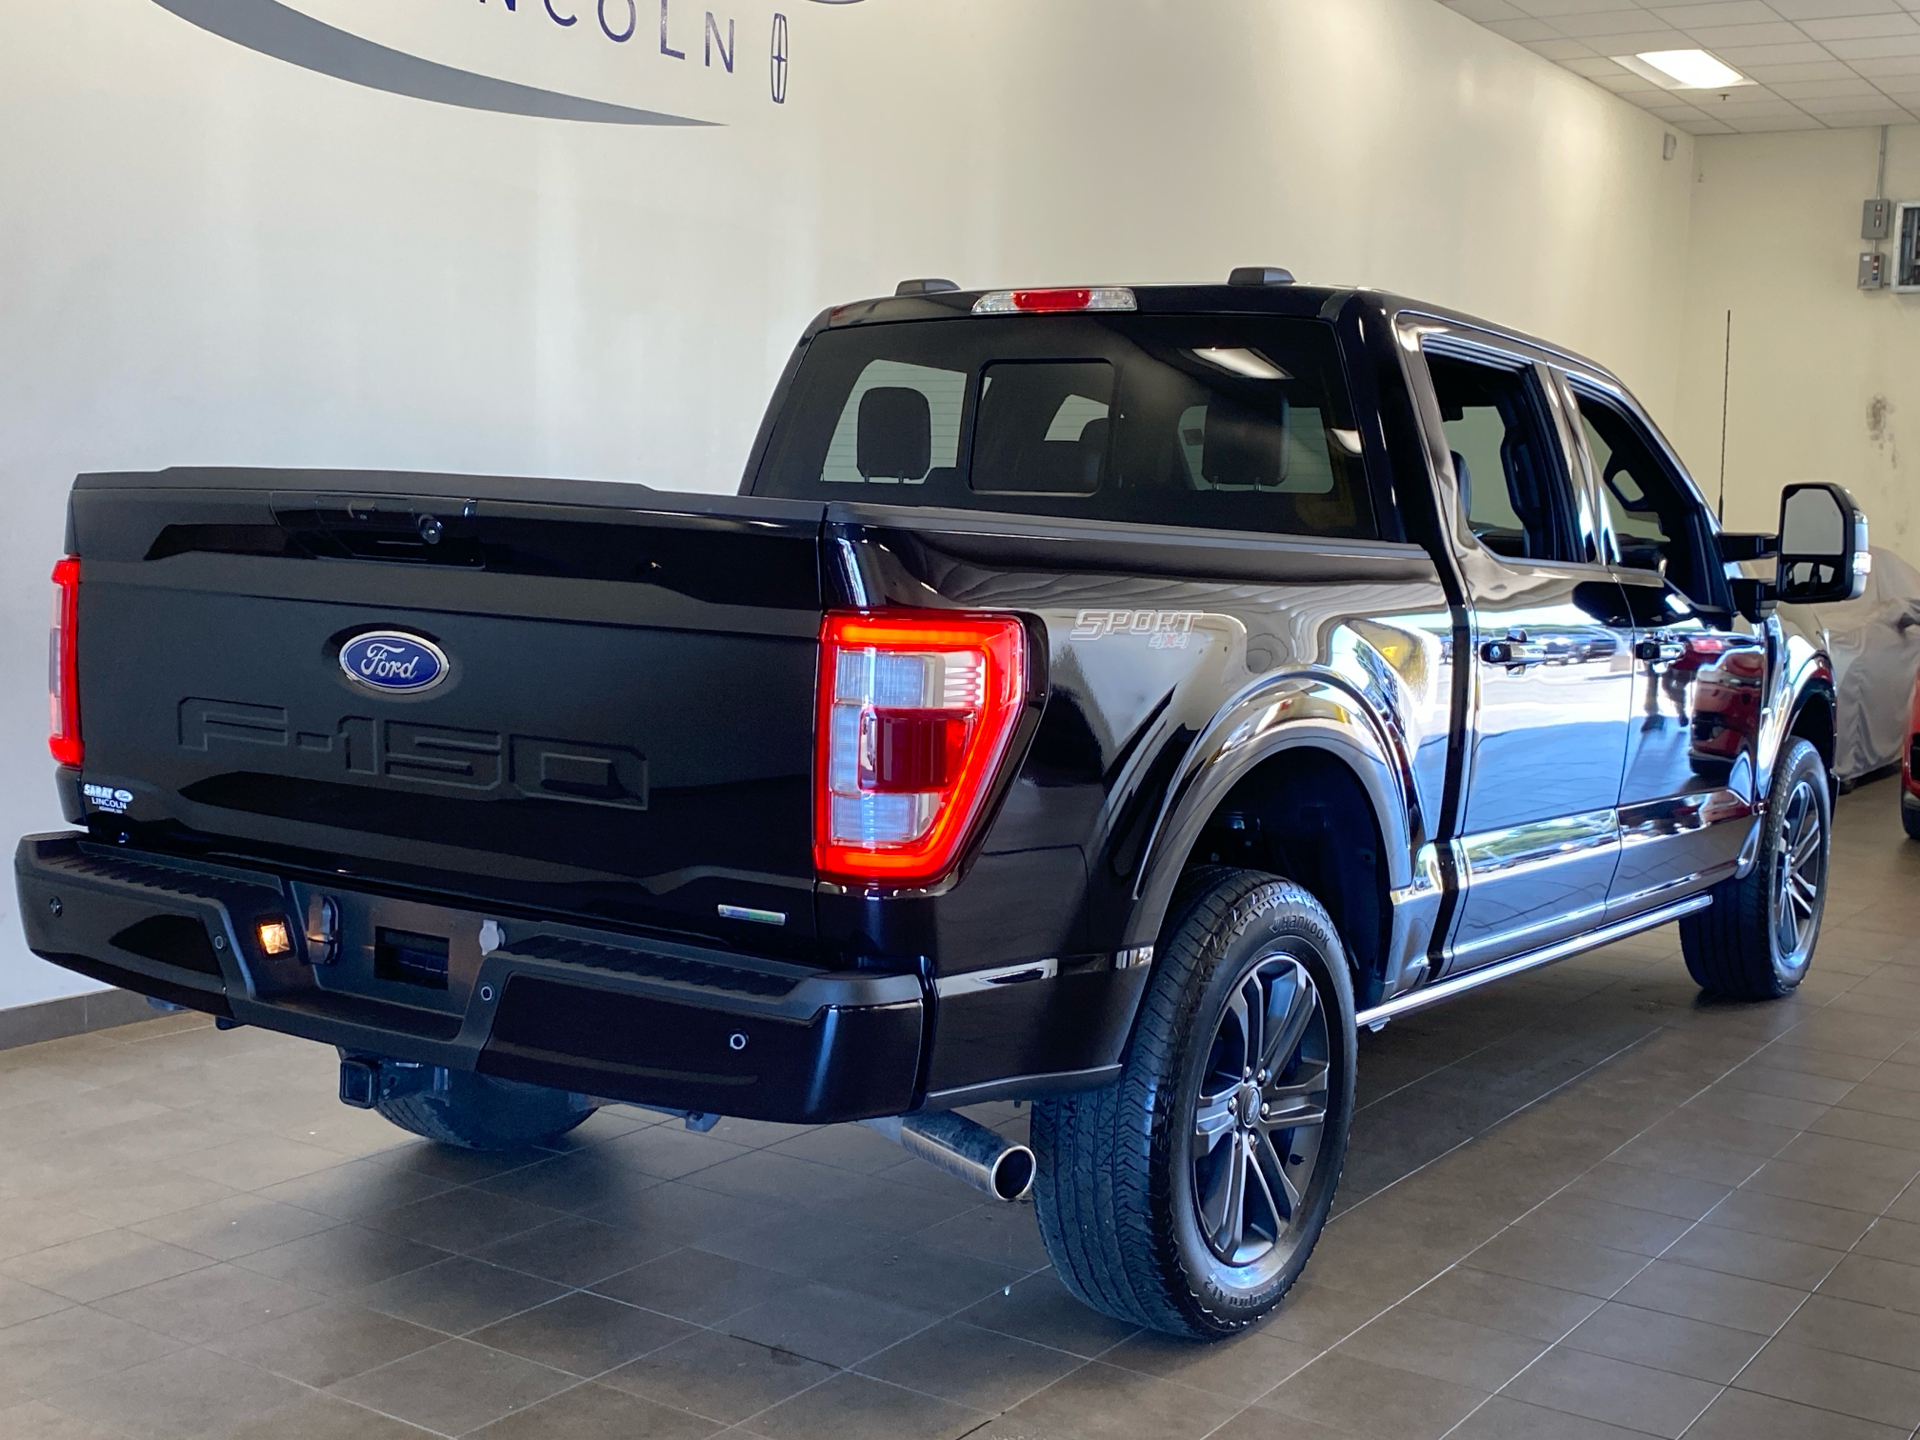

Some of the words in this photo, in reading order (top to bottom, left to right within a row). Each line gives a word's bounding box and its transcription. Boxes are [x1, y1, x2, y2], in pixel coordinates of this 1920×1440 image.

[479, 0, 735, 73] OLN
[1069, 609, 1203, 641] SPORT
[361, 643, 420, 679] Ford
[177, 696, 649, 811] F-150
[83, 783, 114, 800] SARAT
[91, 796, 127, 810] LINCOLN
